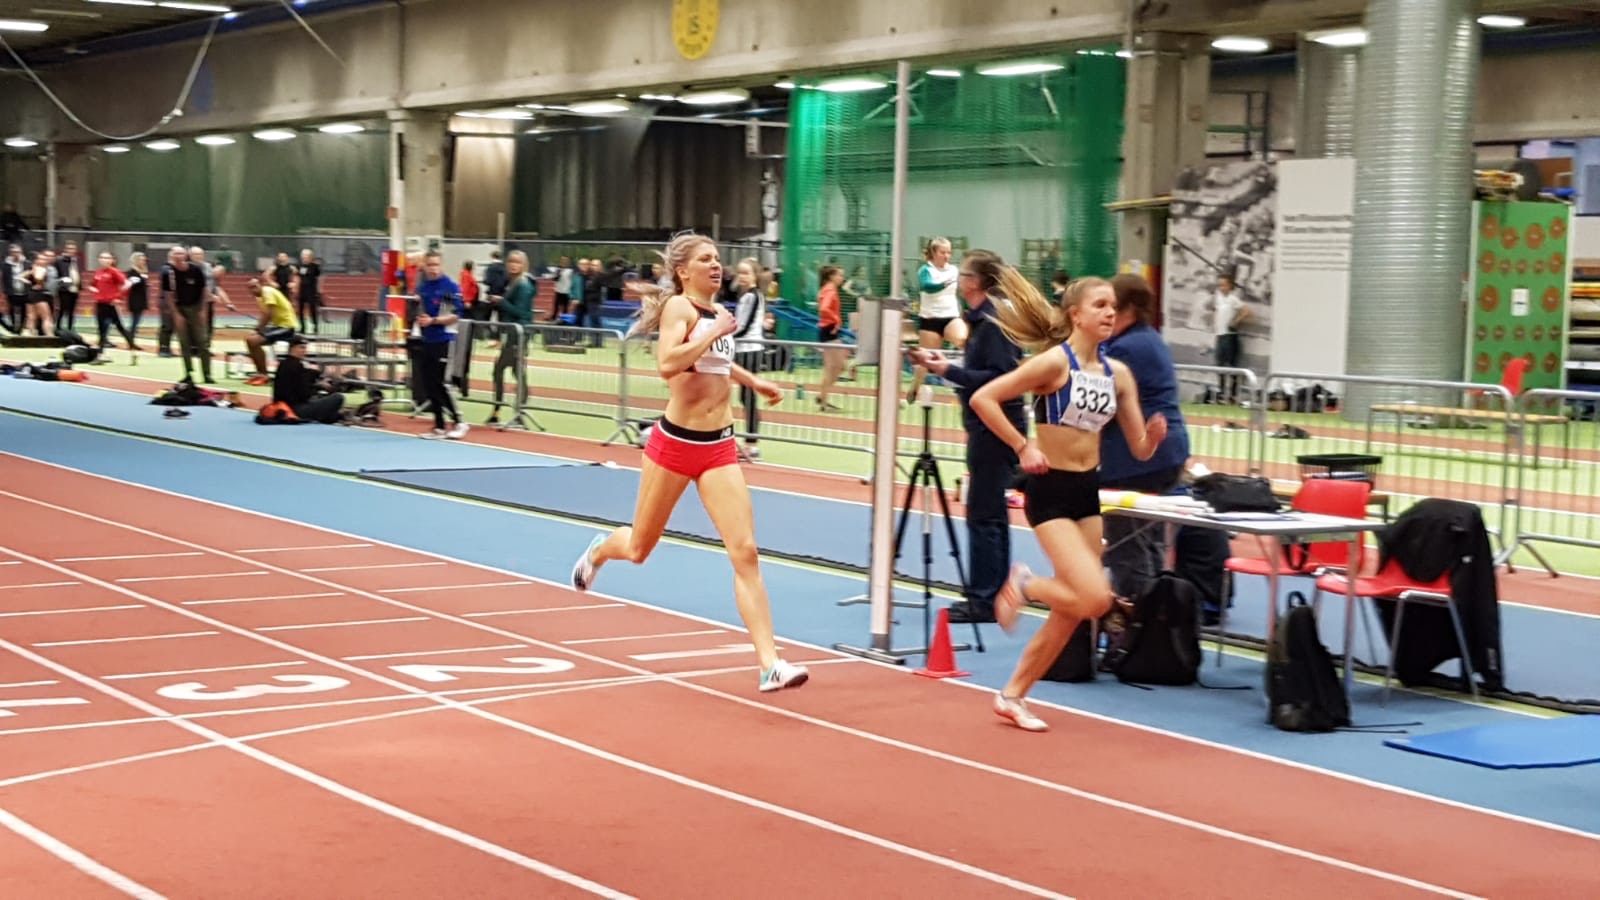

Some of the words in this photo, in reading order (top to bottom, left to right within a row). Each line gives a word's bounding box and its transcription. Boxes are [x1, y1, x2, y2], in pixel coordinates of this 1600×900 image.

[709, 336, 730, 355] 09
[1075, 387, 1111, 415] 332
[387, 657, 576, 682] 2
[155, 674, 351, 700] 3
